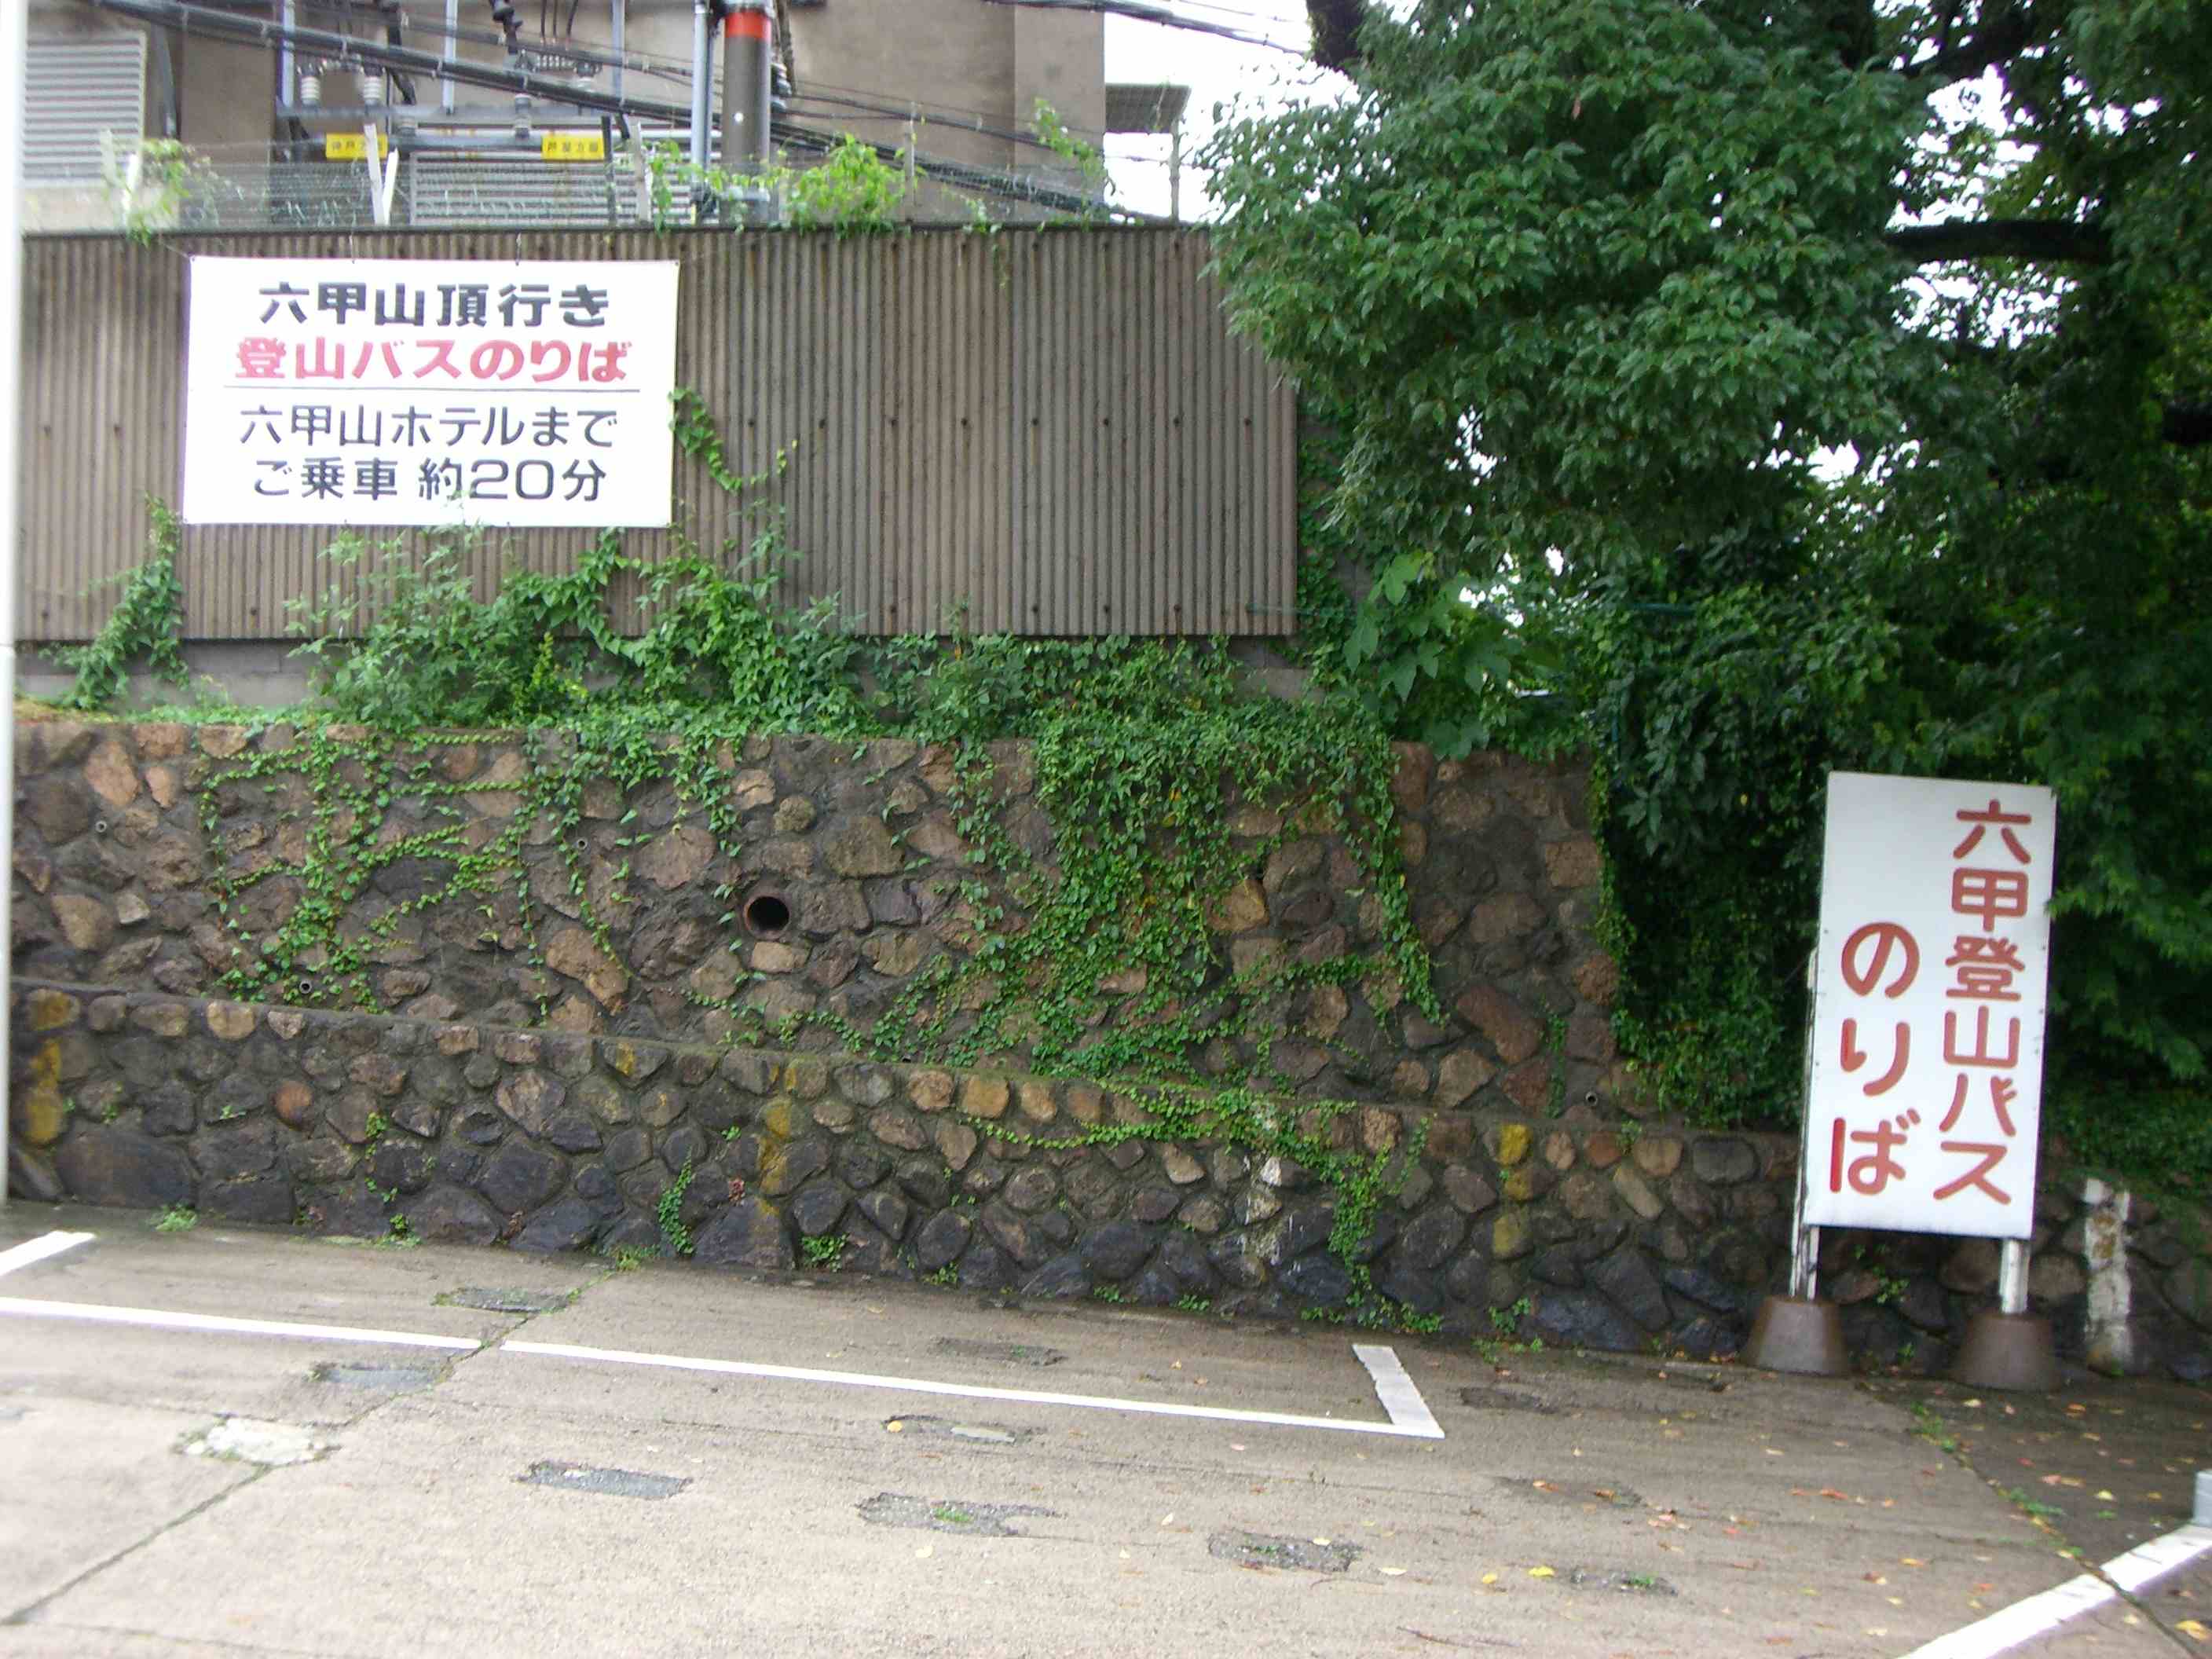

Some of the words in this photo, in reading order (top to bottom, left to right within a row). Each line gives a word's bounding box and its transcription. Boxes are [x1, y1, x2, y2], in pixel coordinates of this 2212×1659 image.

[259, 281, 610, 328] 六甲山頂行き
[236, 336, 632, 383] 登山バスのりば
[240, 405, 618, 448] 六甲山ホテルまで
[255, 457, 398, 501] ご乗車
[418, 457, 607, 502] 約20分
[1932, 799, 2032, 1205] 六甲登山バス
[1829, 921, 1921, 1196] のりば
